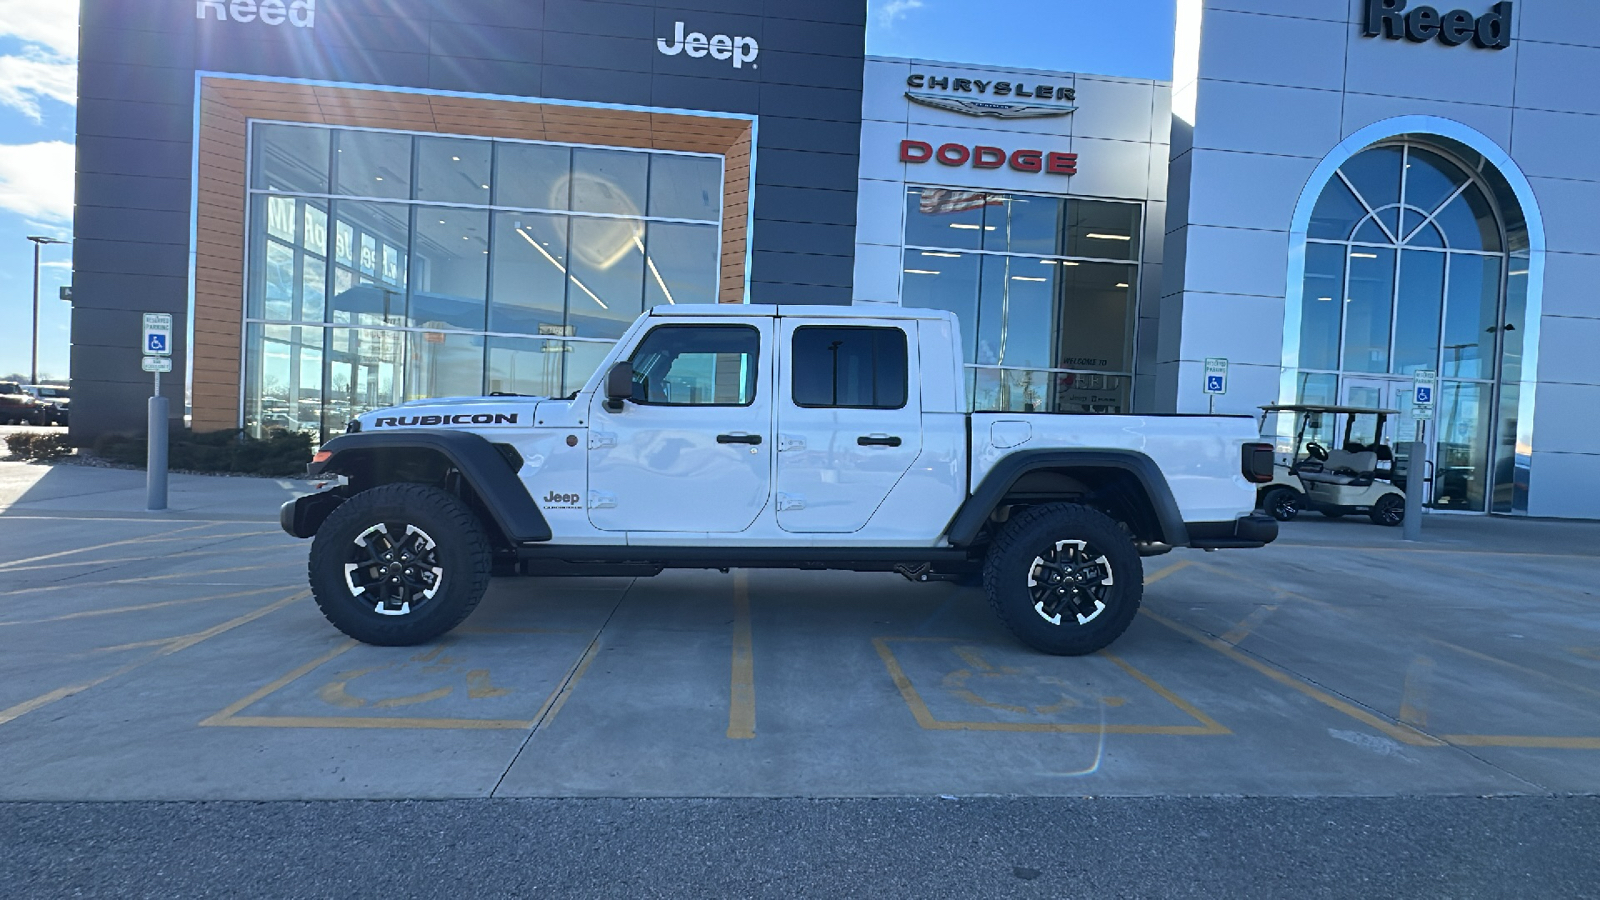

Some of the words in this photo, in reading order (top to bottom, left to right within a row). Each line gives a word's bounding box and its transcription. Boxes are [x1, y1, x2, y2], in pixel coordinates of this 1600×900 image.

[1363, 0, 1513, 50] Reed
[657, 21, 759, 69] Jeep
[907, 74, 1077, 101] CHRYSLER
[900, 139, 1078, 175] DODGE
[1064, 358, 1097, 366] WELCOME
[1099, 359, 1108, 367] TO
[375, 413, 518, 427] RUBICON
[543, 490, 580, 505] Jeep
